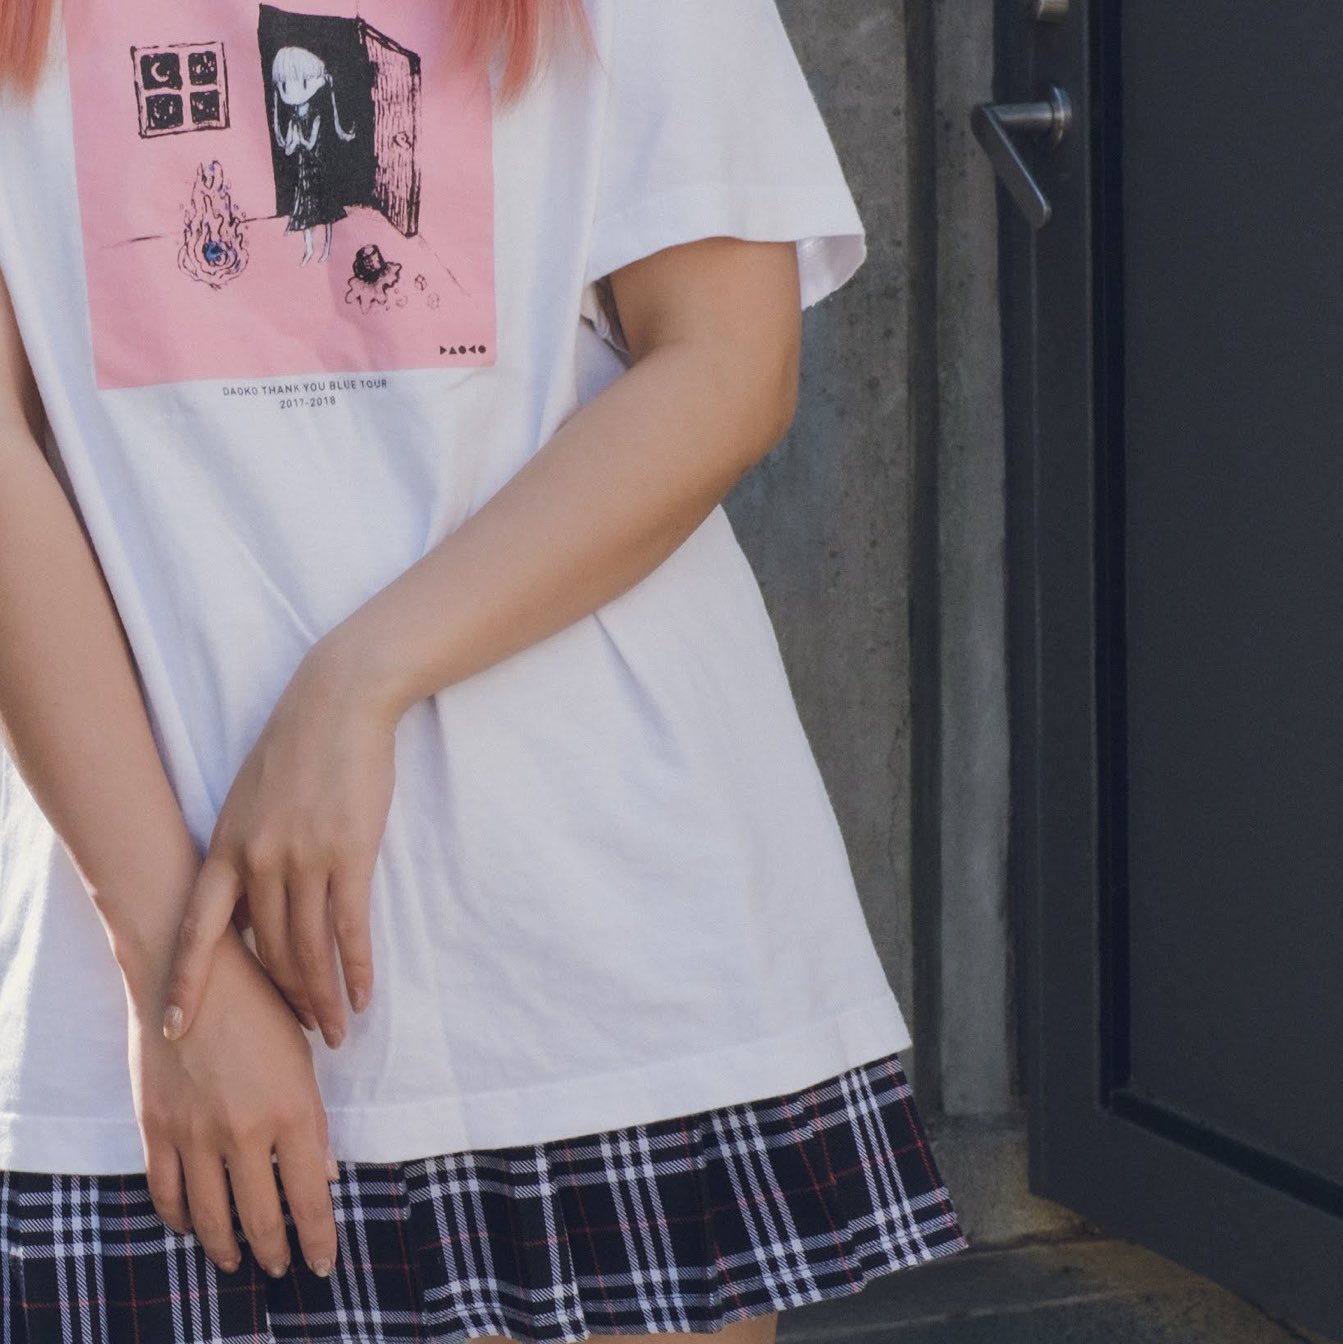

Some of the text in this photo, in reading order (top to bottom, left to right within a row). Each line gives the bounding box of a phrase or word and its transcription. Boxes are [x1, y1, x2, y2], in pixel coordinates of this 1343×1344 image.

[222, 378, 388, 396] DAOKO THANK YOU BLUE TOUR
[279, 395, 337, 409] 2017-2018
